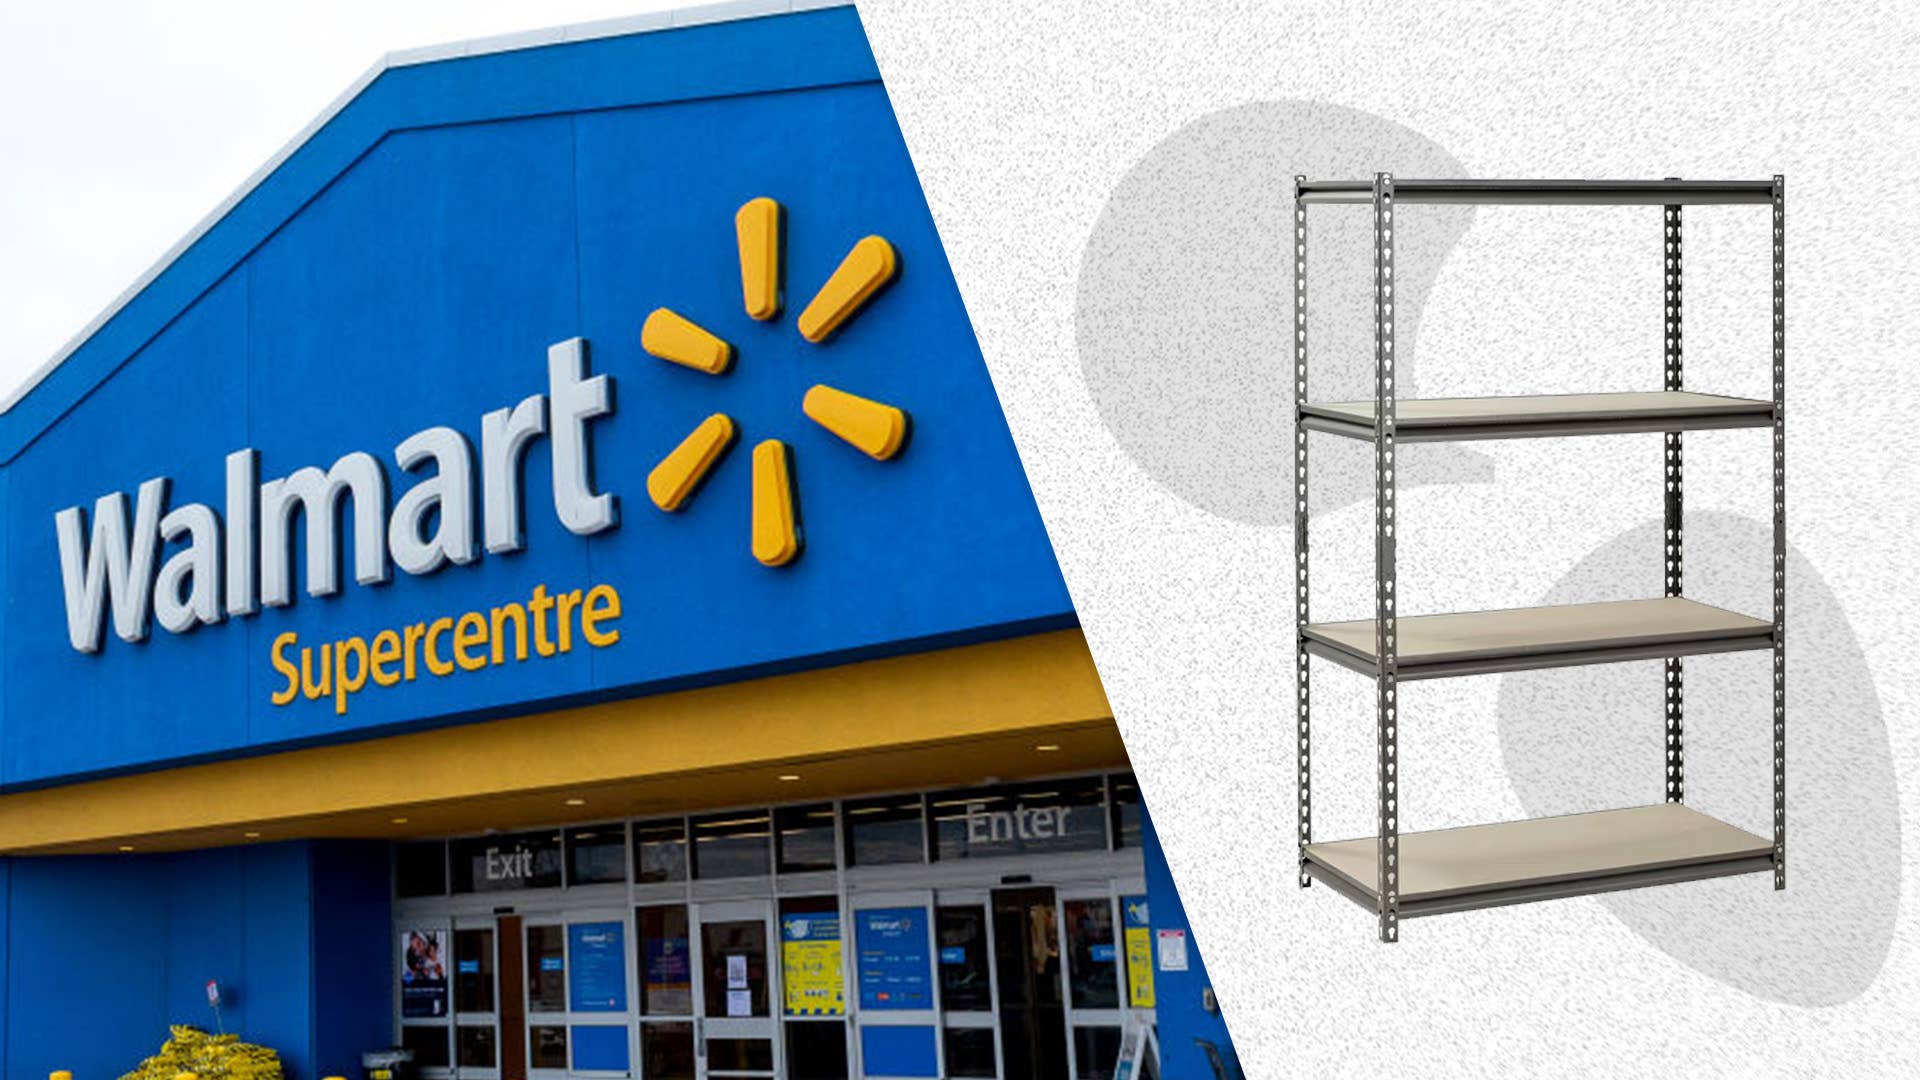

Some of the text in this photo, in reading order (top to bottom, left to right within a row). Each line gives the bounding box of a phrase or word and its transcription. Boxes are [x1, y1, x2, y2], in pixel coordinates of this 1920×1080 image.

[55, 337, 619, 654] Walmart
[271, 584, 623, 713] Supercentre
[486, 846, 533, 879] Exit
[967, 804, 1070, 844] Enter
